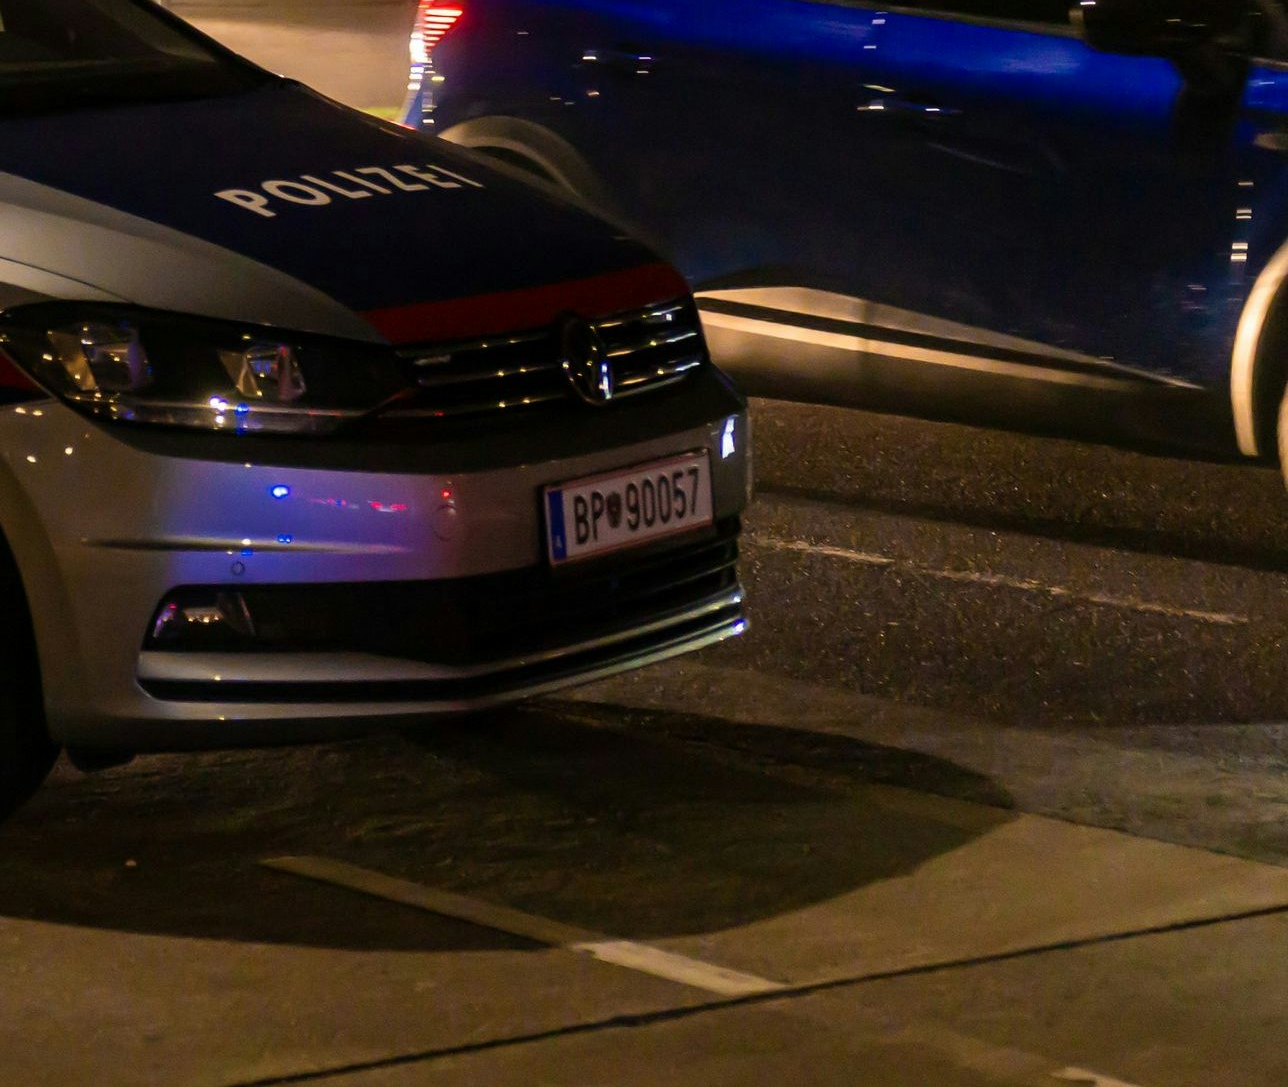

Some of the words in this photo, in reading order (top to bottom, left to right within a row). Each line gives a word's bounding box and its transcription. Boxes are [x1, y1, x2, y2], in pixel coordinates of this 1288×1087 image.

[213, 163, 487, 218] POLIZEI
[574, 490, 605, 545] BP
[626, 466, 699, 530] 90057
